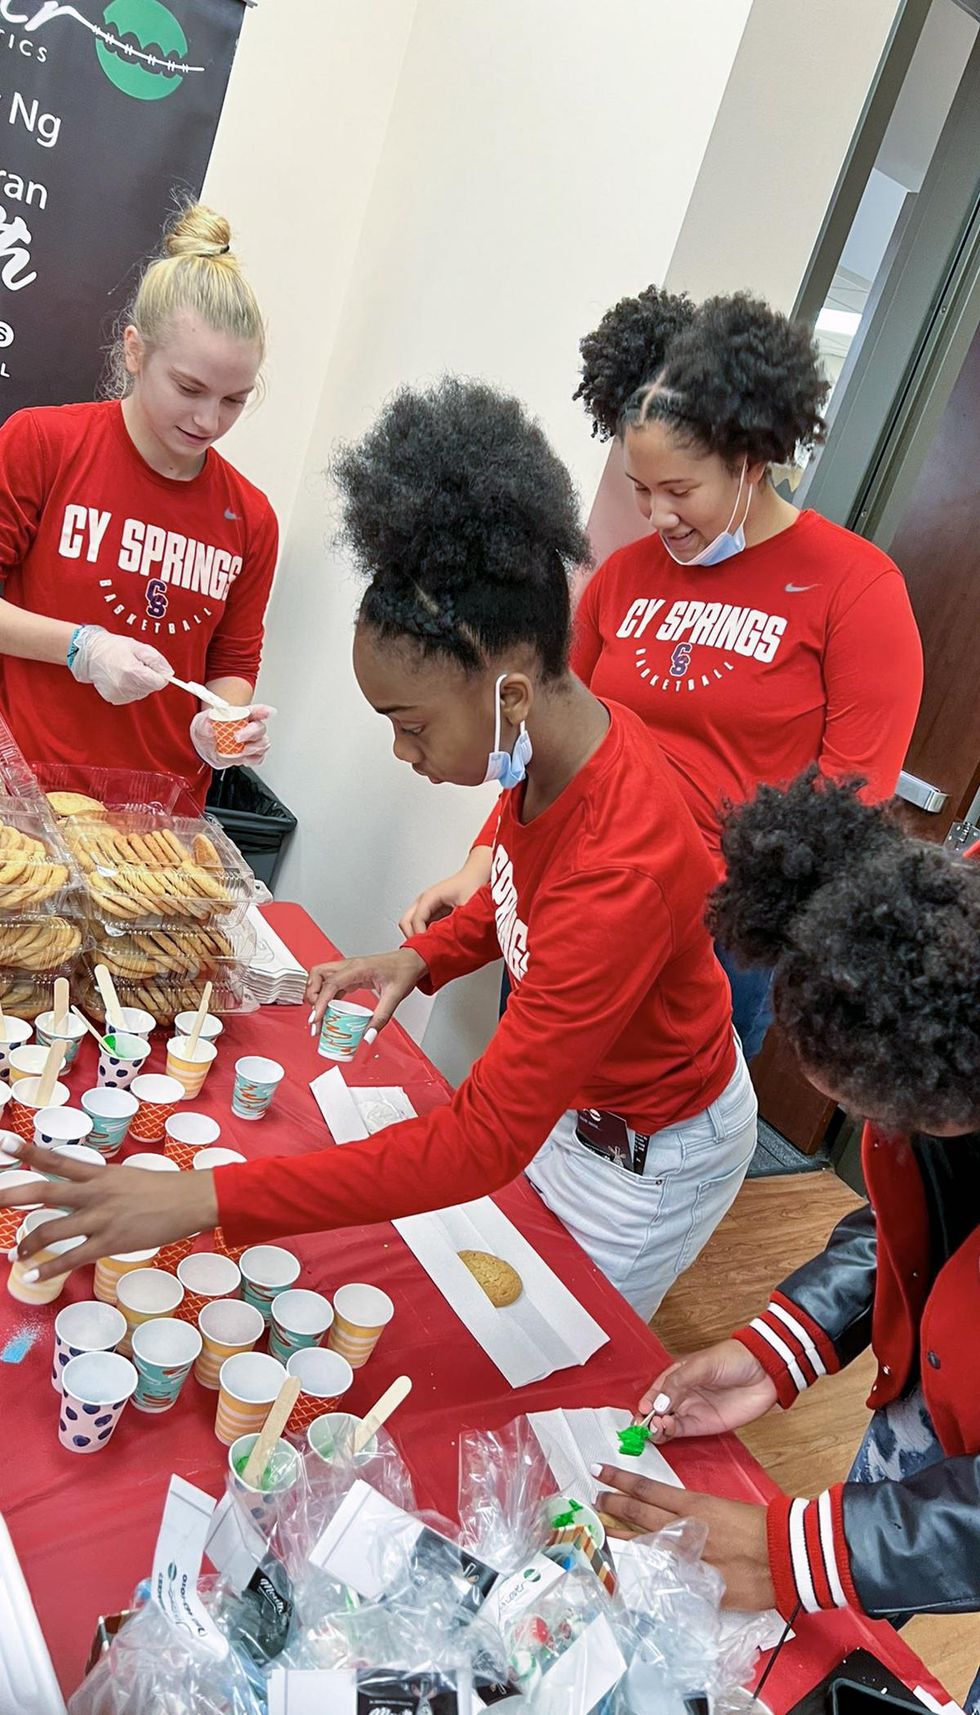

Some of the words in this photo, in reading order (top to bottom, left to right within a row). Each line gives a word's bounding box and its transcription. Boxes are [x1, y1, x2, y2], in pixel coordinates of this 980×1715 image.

[0, 28, 48, 63] ICS
[8, 91, 62, 148] Ng
[58, 504, 112, 563] CY
[117, 518, 243, 601] SPRINGS
[99, 578, 212, 634] BASKETBALL
[615, 598, 666, 639] CY
[655, 601, 788, 664] SPRINGS
[635, 648, 734, 692] BASKETBALL
[491, 844, 531, 982] SPRING
